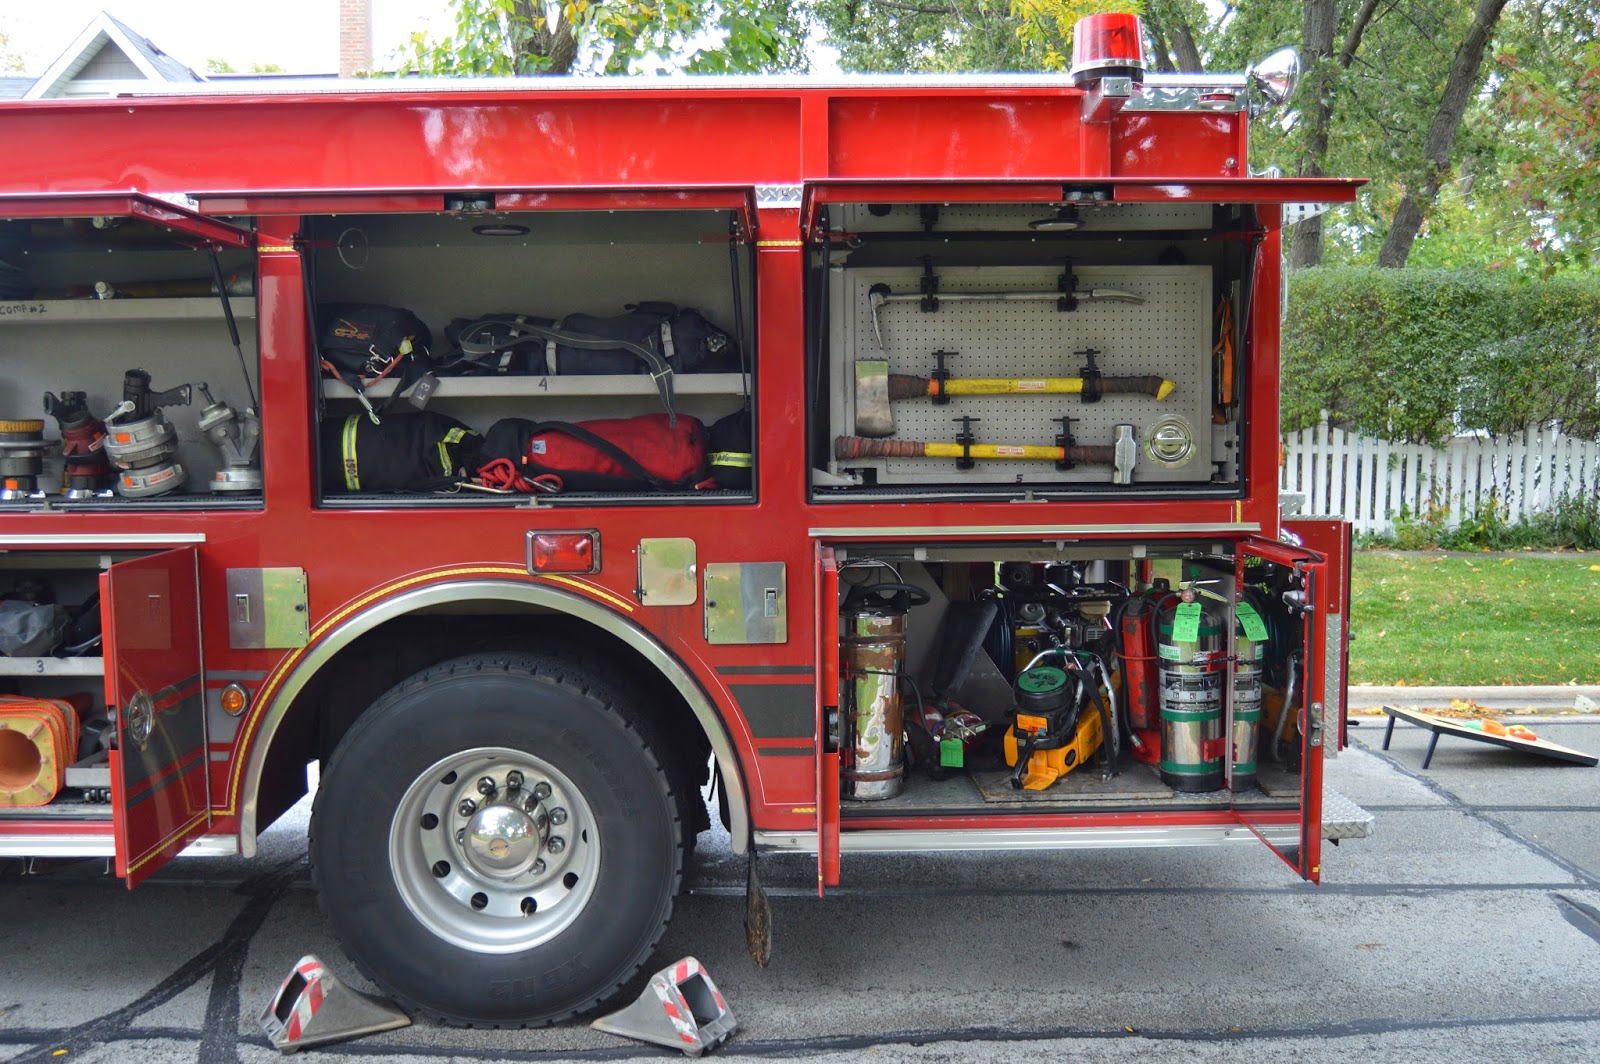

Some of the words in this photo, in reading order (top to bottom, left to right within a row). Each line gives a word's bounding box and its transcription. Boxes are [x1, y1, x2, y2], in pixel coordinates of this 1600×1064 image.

[538, 376, 548, 392] 4
[1016, 473, 1024, 483] 5
[36, 659, 45, 673] 3
